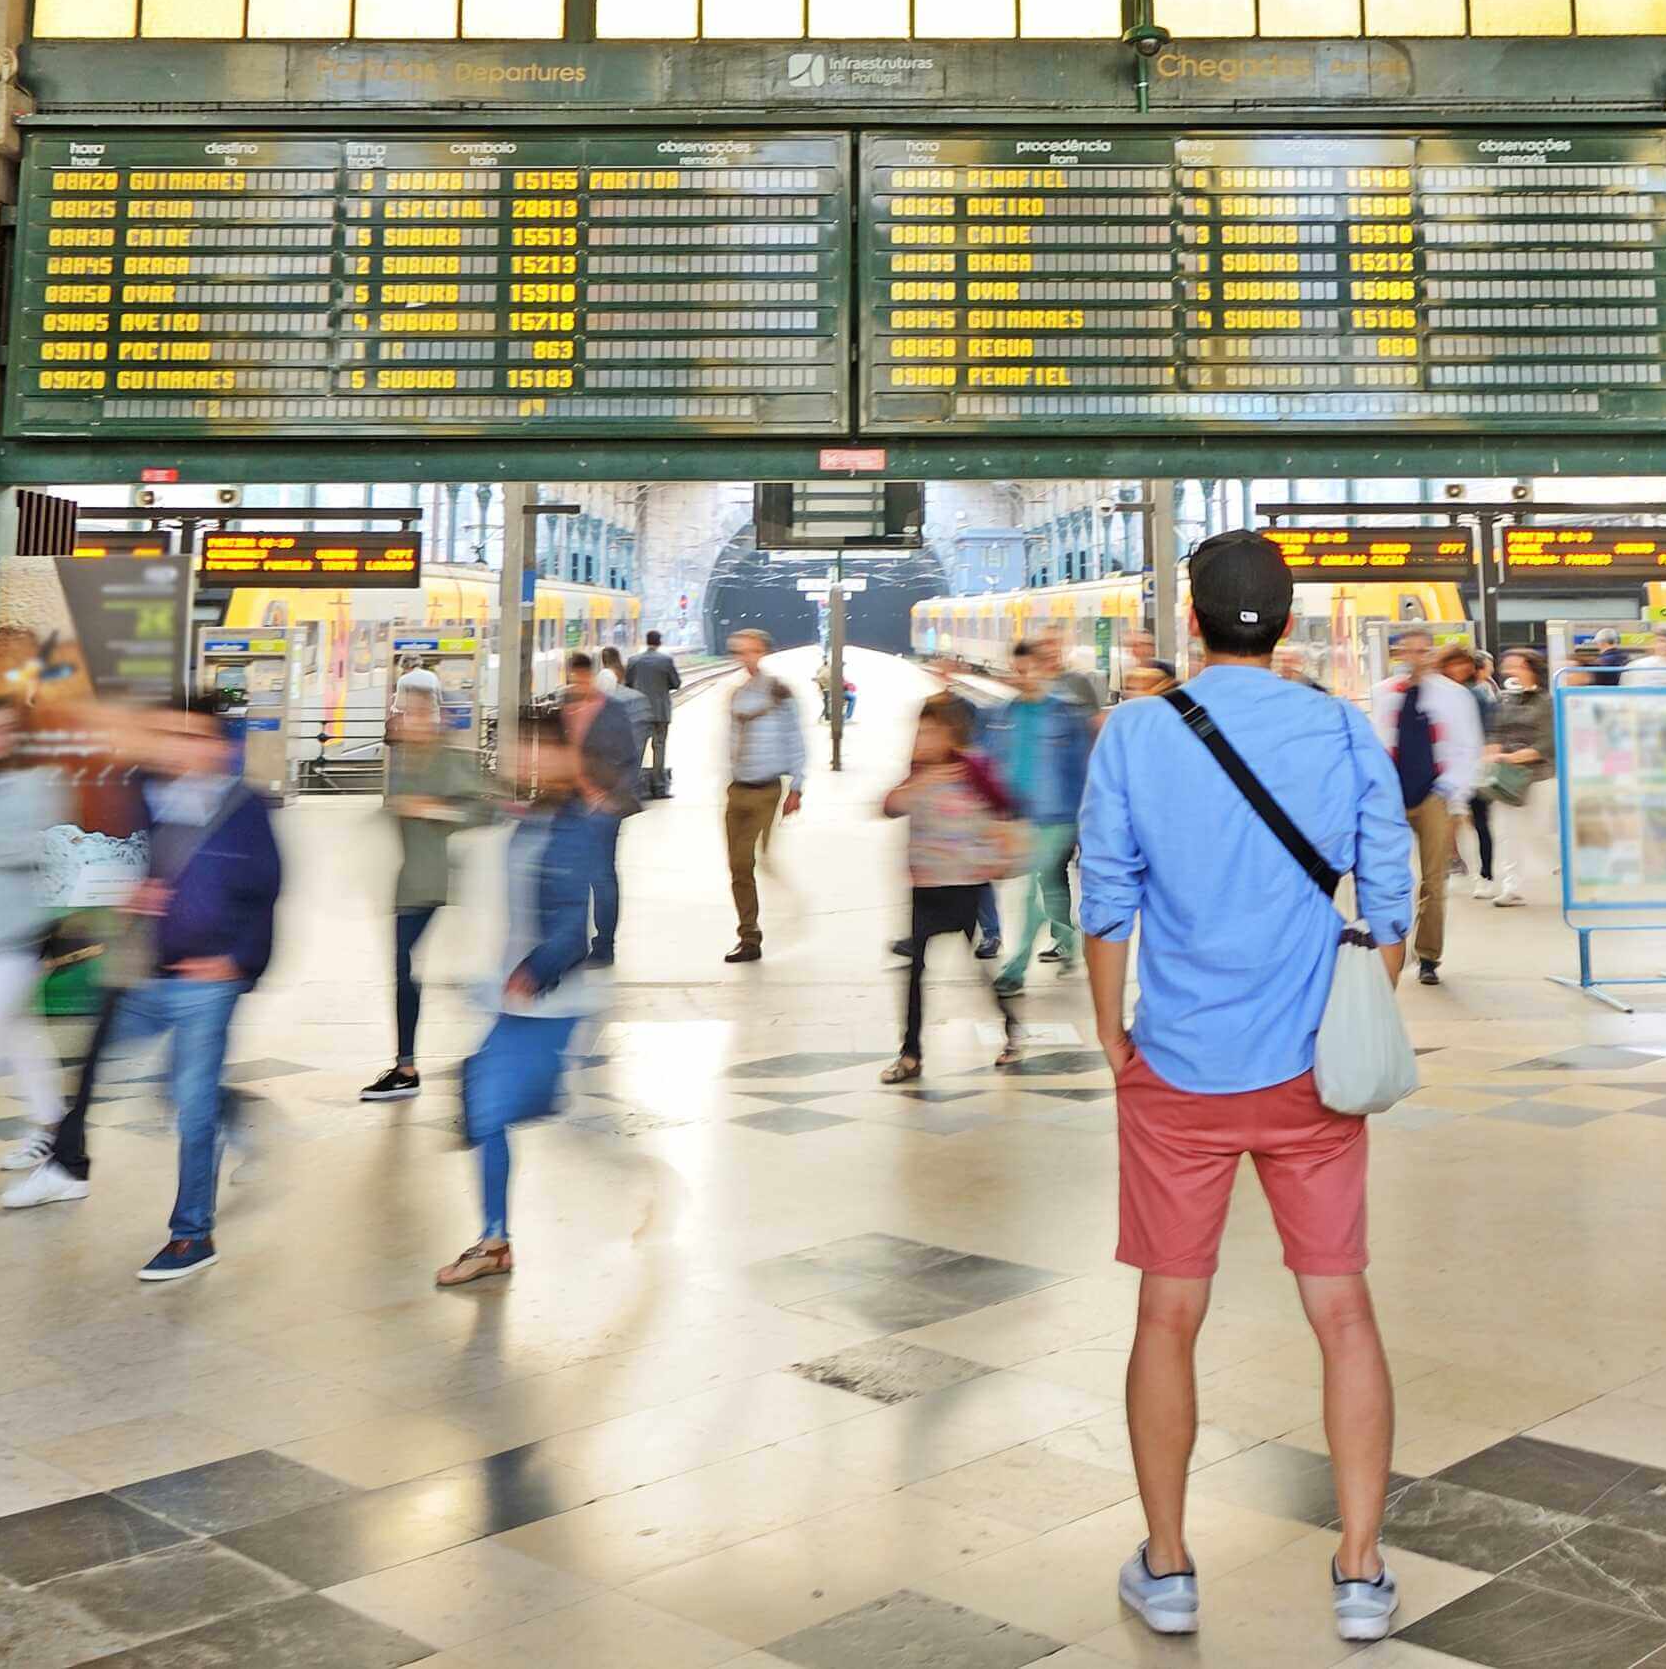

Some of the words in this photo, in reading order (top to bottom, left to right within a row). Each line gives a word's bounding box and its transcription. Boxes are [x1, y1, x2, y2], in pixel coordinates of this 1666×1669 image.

[454, 61, 587, 83] Departures
[829, 56, 934, 69] Infraestruturas
[829, 72, 846, 83] de
[851, 72, 903, 86] Portugal
[70, 142, 106, 155] hora
[204, 142, 258, 155] destino
[449, 141, 517, 155] comboio
[656, 141, 751, 156] observações
[906, 140, 940, 152] hora
[1016, 140, 1112, 154] procedência
[1478, 139, 1572, 154] observações
[71, 156, 101, 166] hour
[224, 156, 238, 166] to
[1050, 154, 1079, 164] from
[53, 172, 118, 191] 08H20
[129, 172, 246, 190] GUIMARAES
[386, 172, 463, 190] SUBURB
[513, 171, 578, 190] 15155
[589, 171, 680, 189] PARTIDA
[966, 170, 1069, 188] PENAFIEL
[50, 200, 116, 218] 08H25
[127, 200, 193, 218] REGUA
[384, 200, 487, 218] ESPECIAL
[512, 200, 578, 218] 20813
[966, 197, 1045, 216] AVEIRO
[48, 228, 114, 247] 08H30
[126, 228, 190, 247] CAIDE
[383, 228, 461, 246] SUBURB
[511, 227, 578, 246] 15513
[966, 225, 1032, 244] CAIDE
[1196, 225, 1210, 244] 3
[1221, 225, 1299, 244] SUBURB
[1348, 225, 1414, 244] 15510
[47, 256, 113, 275] 08H45
[123, 256, 190, 275] BRAGA
[356, 256, 371, 274] 2
[382, 256, 461, 274] SUBURB
[510, 255, 577, 274] 15213
[966, 253, 1032, 272] BRAGA
[1197, 253, 1209, 272] 1
[1221, 253, 1299, 272] SUBURB
[1349, 253, 1414, 272] 15212
[45, 285, 111, 303] 08H50
[122, 285, 175, 303] OVAR
[354, 284, 370, 303] 5
[381, 284, 459, 303] SUBURB
[510, 283, 576, 302] 15910
[967, 282, 1020, 301] OVAR
[1197, 282, 1212, 301] 5
[1222, 282, 1300, 301] SUBURB
[43, 313, 109, 332] 09H05
[120, 313, 200, 332] AVEIRO
[379, 312, 458, 331] SUBURB
[509, 312, 575, 331] 15718
[967, 310, 1084, 329] GUIMARAES
[1223, 310, 1301, 329] SUBURB
[1351, 309, 1416, 329] 15186
[40, 342, 107, 360] 09H10
[117, 342, 212, 360] POCINHO
[533, 341, 574, 359] 863
[890, 338, 956, 357] 08H50
[967, 338, 1033, 357] REGUA
[39, 370, 106, 389] 09H20
[116, 370, 235, 389] GUIMARAES
[351, 370, 366, 389] 5
[377, 370, 456, 389] SUBURB
[507, 369, 574, 389] 15183
[890, 367, 956, 386] 09H00
[967, 367, 1071, 386] PENAFIEL
